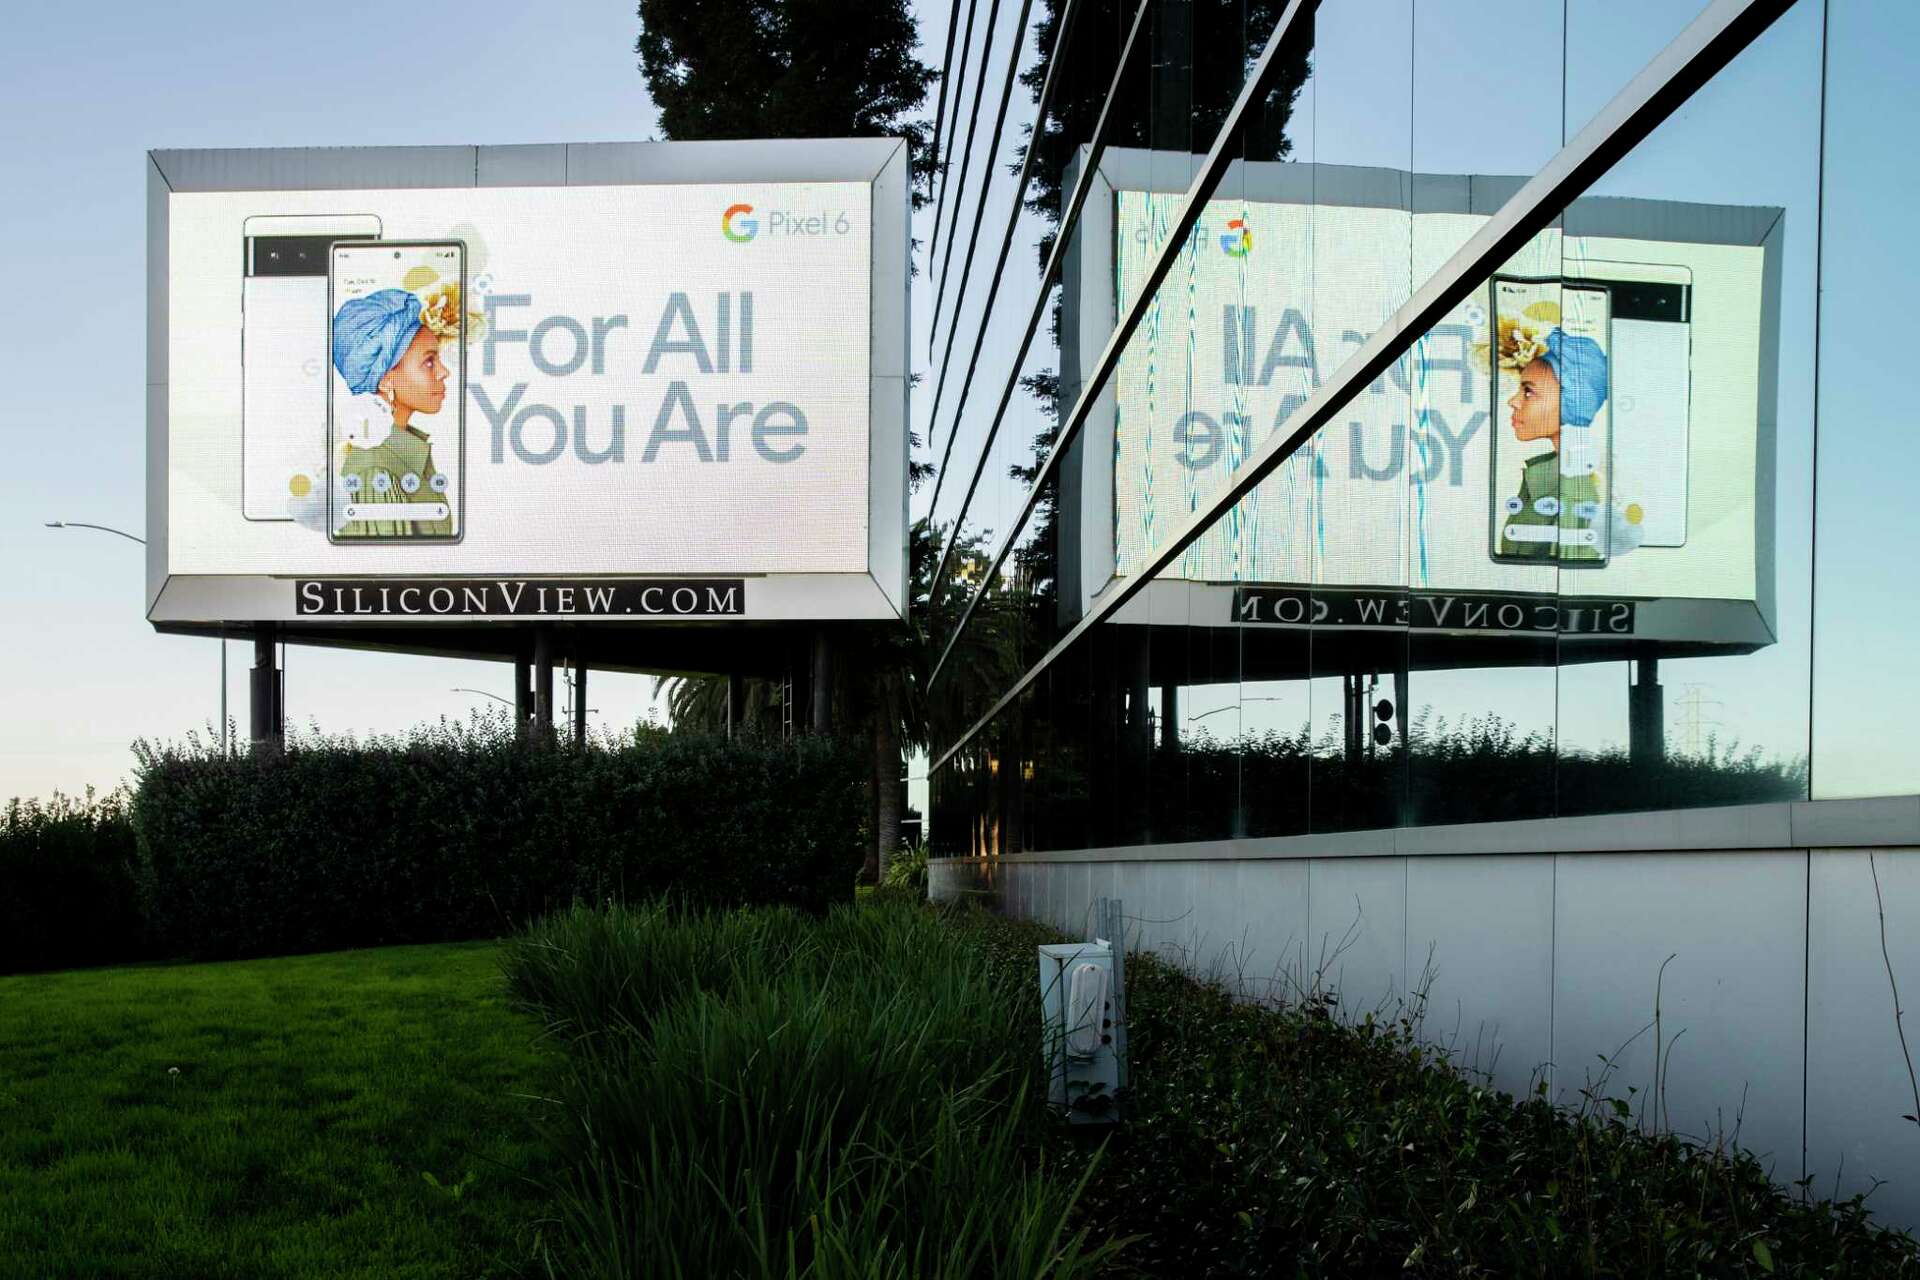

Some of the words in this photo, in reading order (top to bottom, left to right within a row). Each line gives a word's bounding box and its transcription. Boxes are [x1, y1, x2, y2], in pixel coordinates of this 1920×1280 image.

[722, 203, 759, 243] G
[769, 211, 827, 236] Pixel
[834, 210, 850, 235] 6
[483, 294, 628, 376] For
[641, 291, 754, 374] All
[468, 383, 625, 465] You
[641, 381, 808, 463] Are
[302, 582, 738, 614] SILICONVIEW.COM
